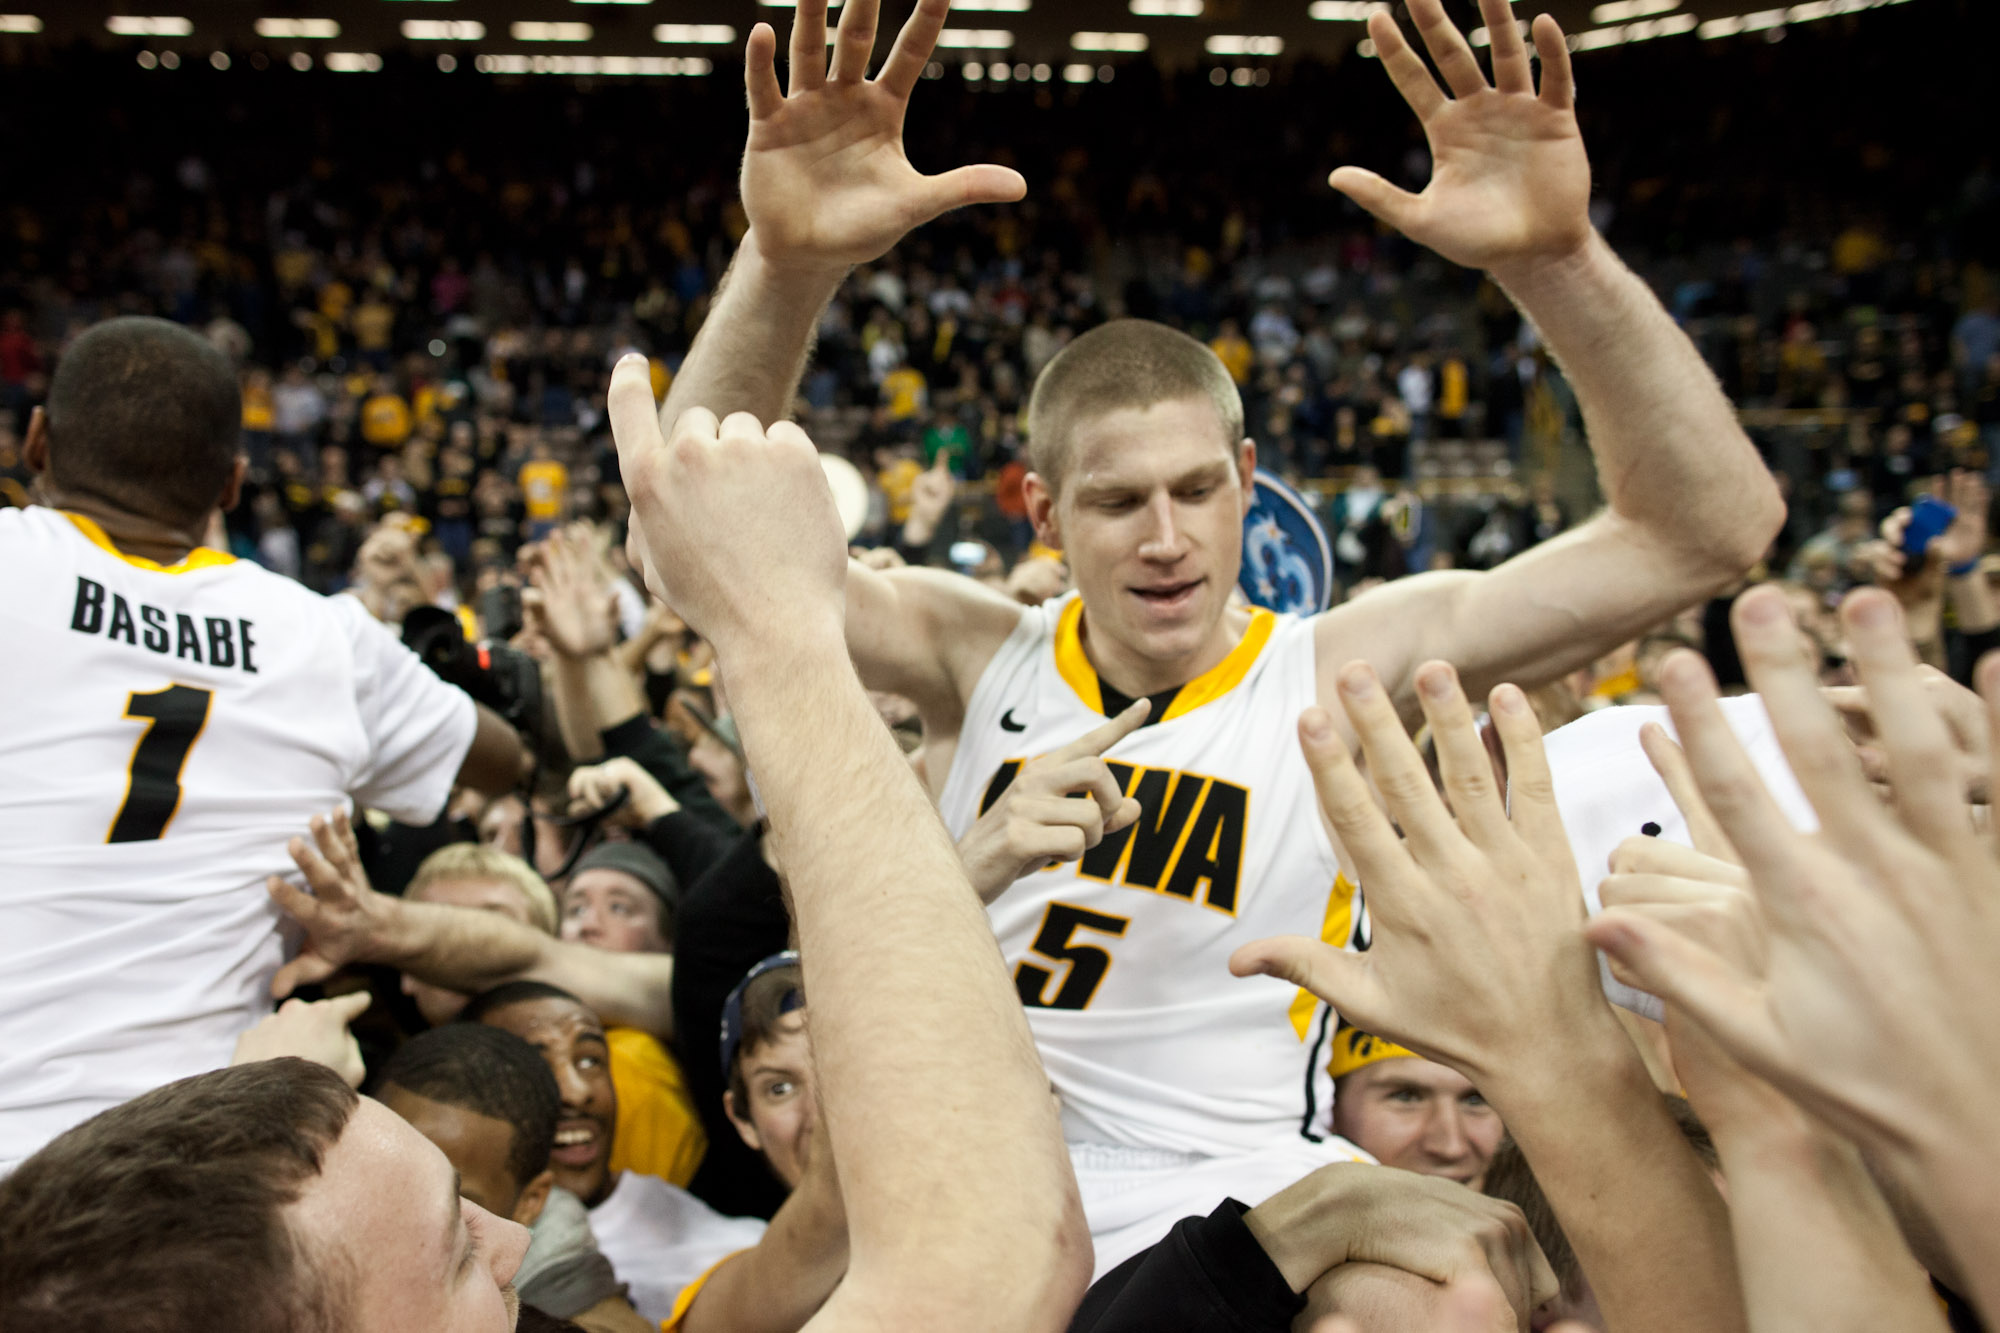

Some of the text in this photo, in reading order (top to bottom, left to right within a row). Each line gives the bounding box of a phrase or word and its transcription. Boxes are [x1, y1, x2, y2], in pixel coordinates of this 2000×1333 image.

[70, 575, 259, 674] BASABE
[106, 681, 215, 845] 1
[977, 754, 1251, 919] WA
[1013, 901, 1133, 1011] 5
